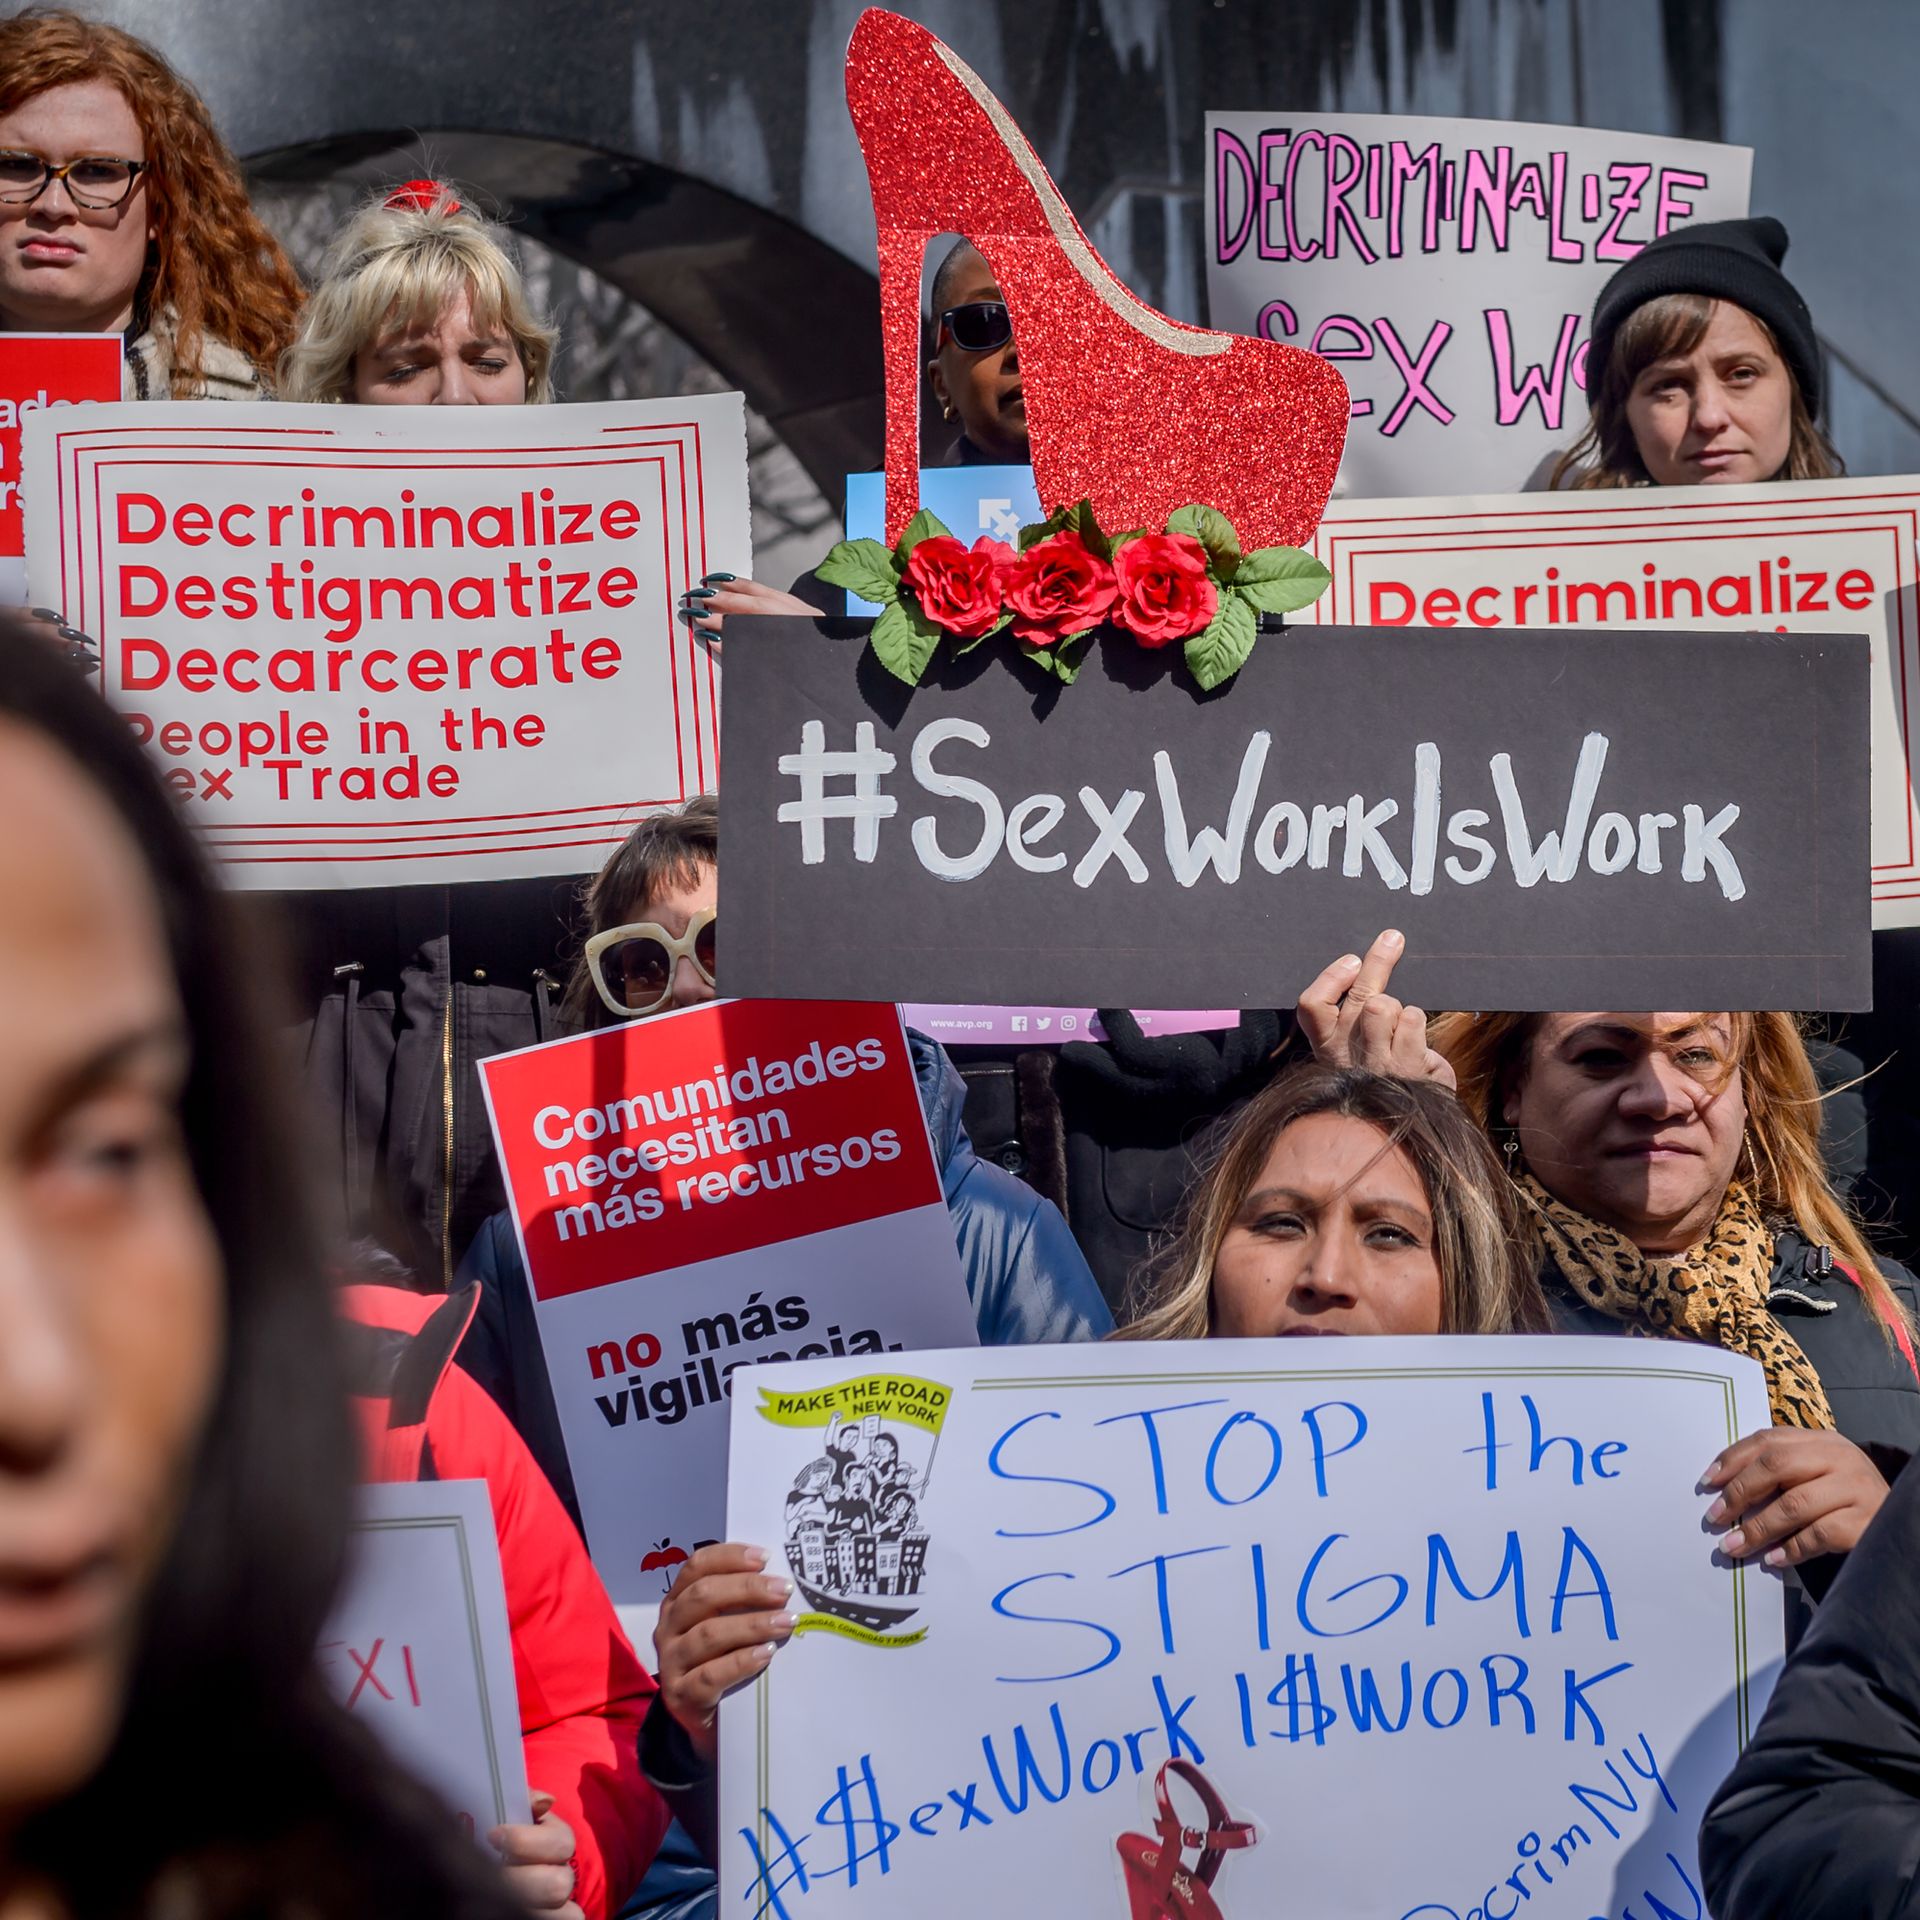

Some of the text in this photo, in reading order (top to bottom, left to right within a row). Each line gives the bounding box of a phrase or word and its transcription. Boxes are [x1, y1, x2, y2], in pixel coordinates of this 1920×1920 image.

[116, 487, 641, 548] Decriminalize
[119, 558, 639, 642] Destigmatize
[1369, 556, 1875, 628] Decriminalize
[121, 629, 623, 692] Decarcerate
[358, 707, 410, 754] in
[439, 708, 546, 753] the
[160, 755, 460, 802] ex Trade
[929, 1017, 993, 1031] www.avp.org
[533, 1037, 886, 1151] Comunidades
[543, 1107, 792, 1198] necesitan
[553, 1127, 902, 1242] más recursos
[586, 1291, 811, 1380] no más
[777, 1380, 946, 1414] MAKE THE ROAD
[852, 1399, 940, 1424] NEW YORK
[988, 1391, 1629, 1538] STOP the
[990, 1525, 1619, 1683] STIGMA
